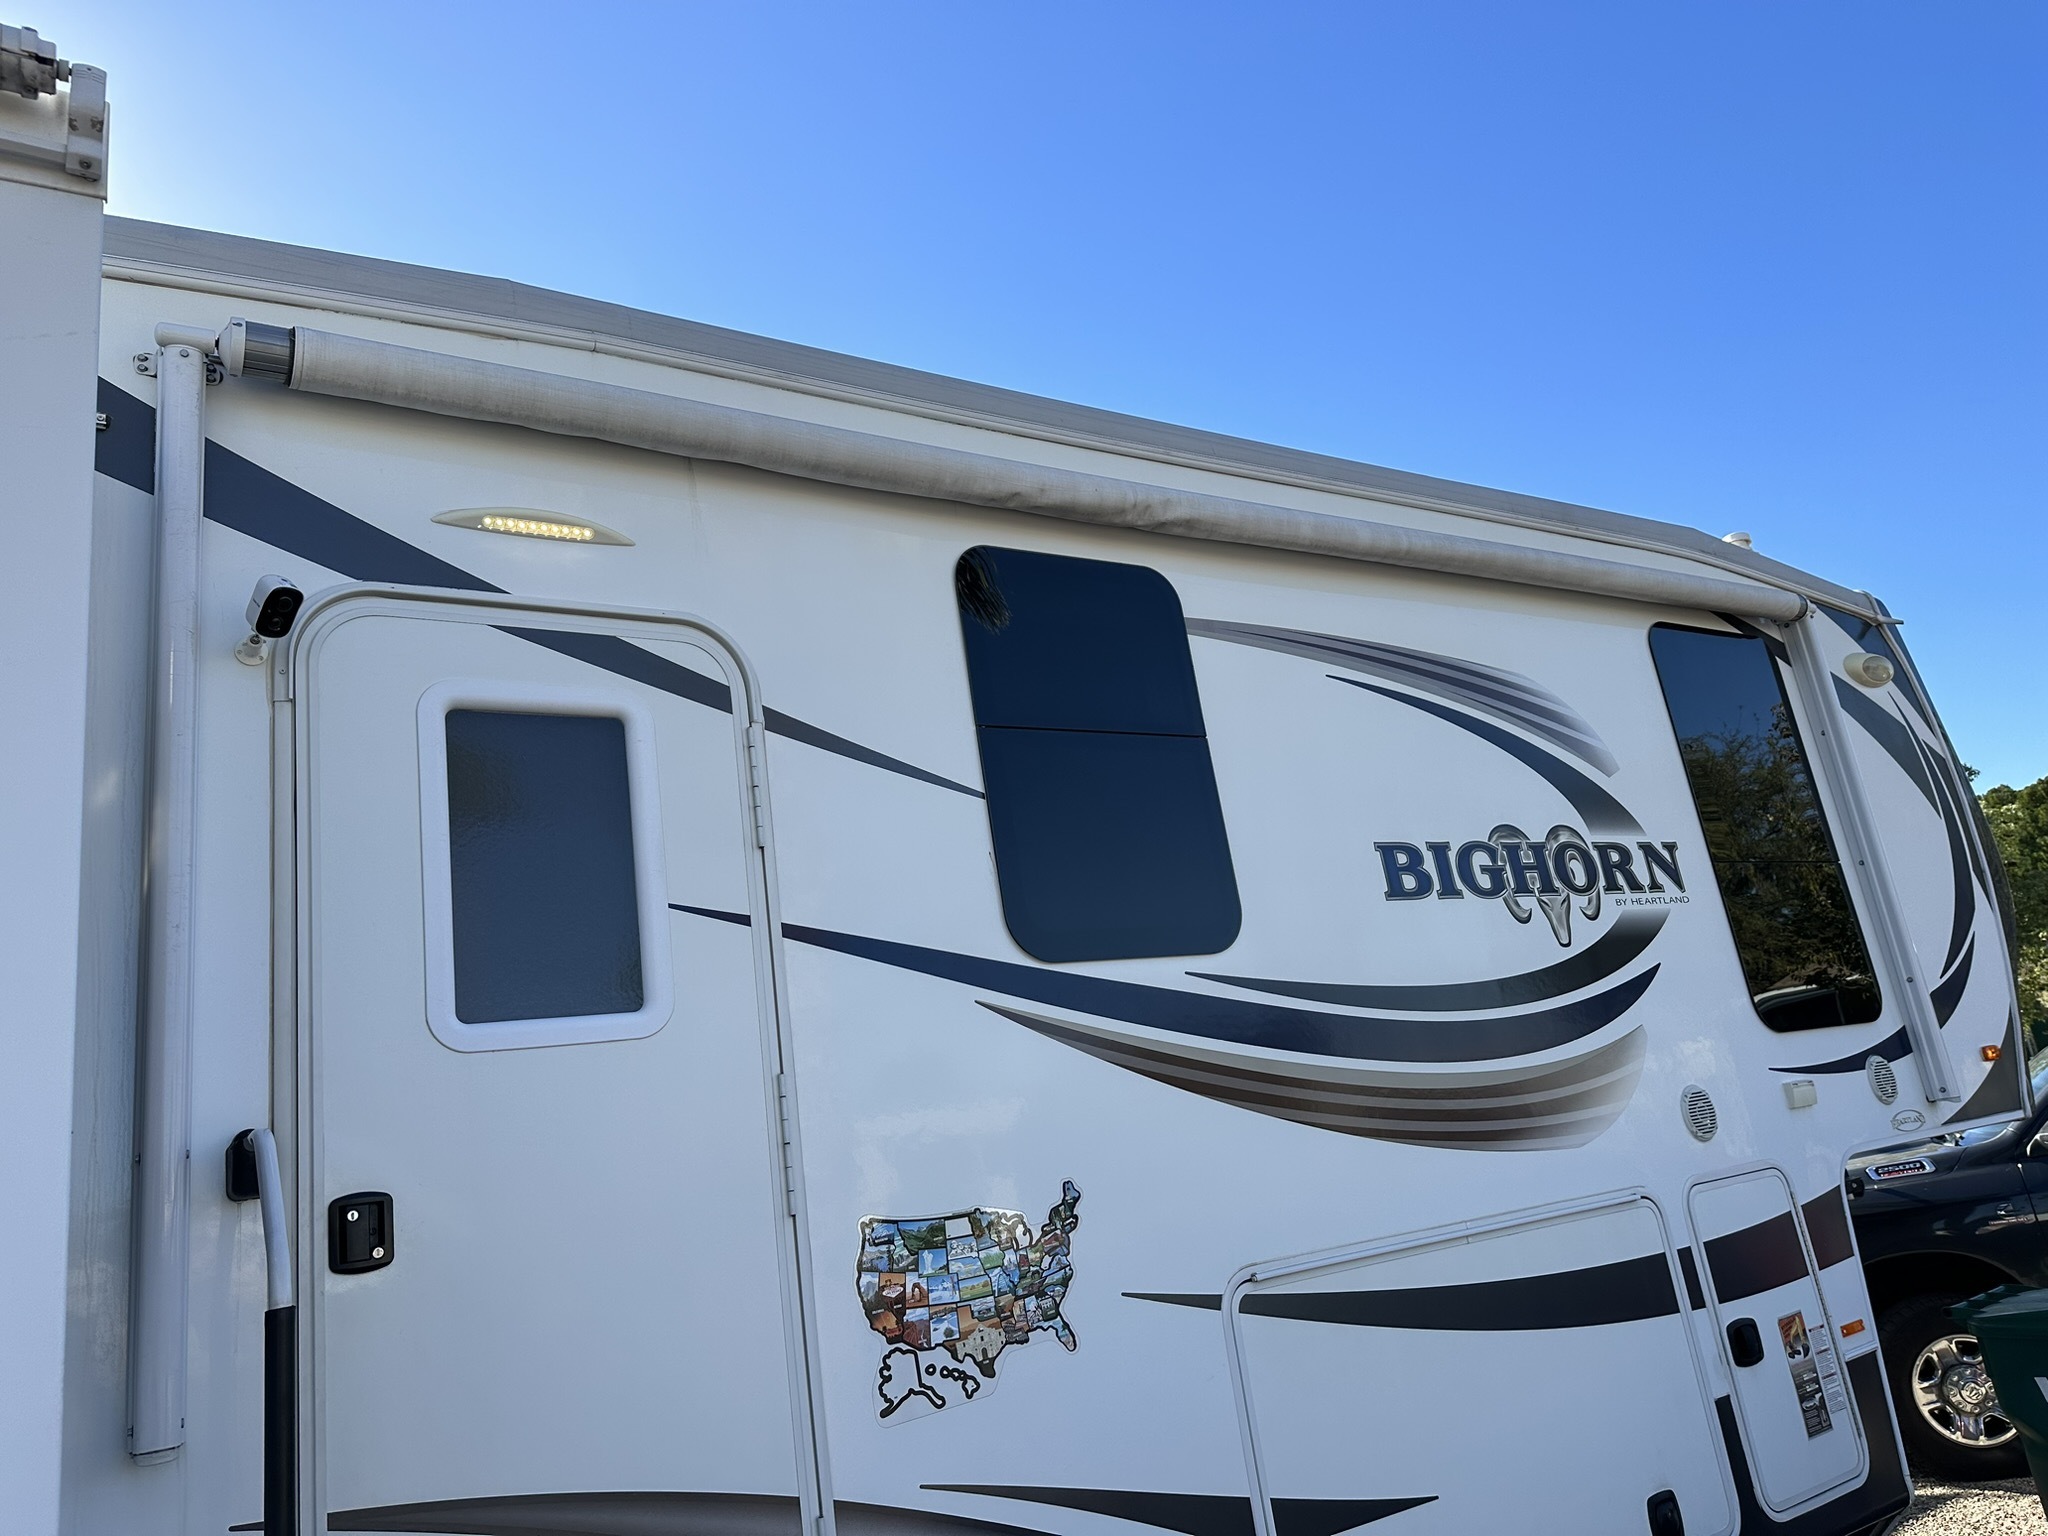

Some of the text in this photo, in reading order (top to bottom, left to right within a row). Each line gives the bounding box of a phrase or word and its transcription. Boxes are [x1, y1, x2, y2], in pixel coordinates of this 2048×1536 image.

[1373, 841, 1686, 901] BIGHORN
[1615, 896, 1690, 906] BY HEARTLAND
[1878, 1162, 1921, 1173] 2500
